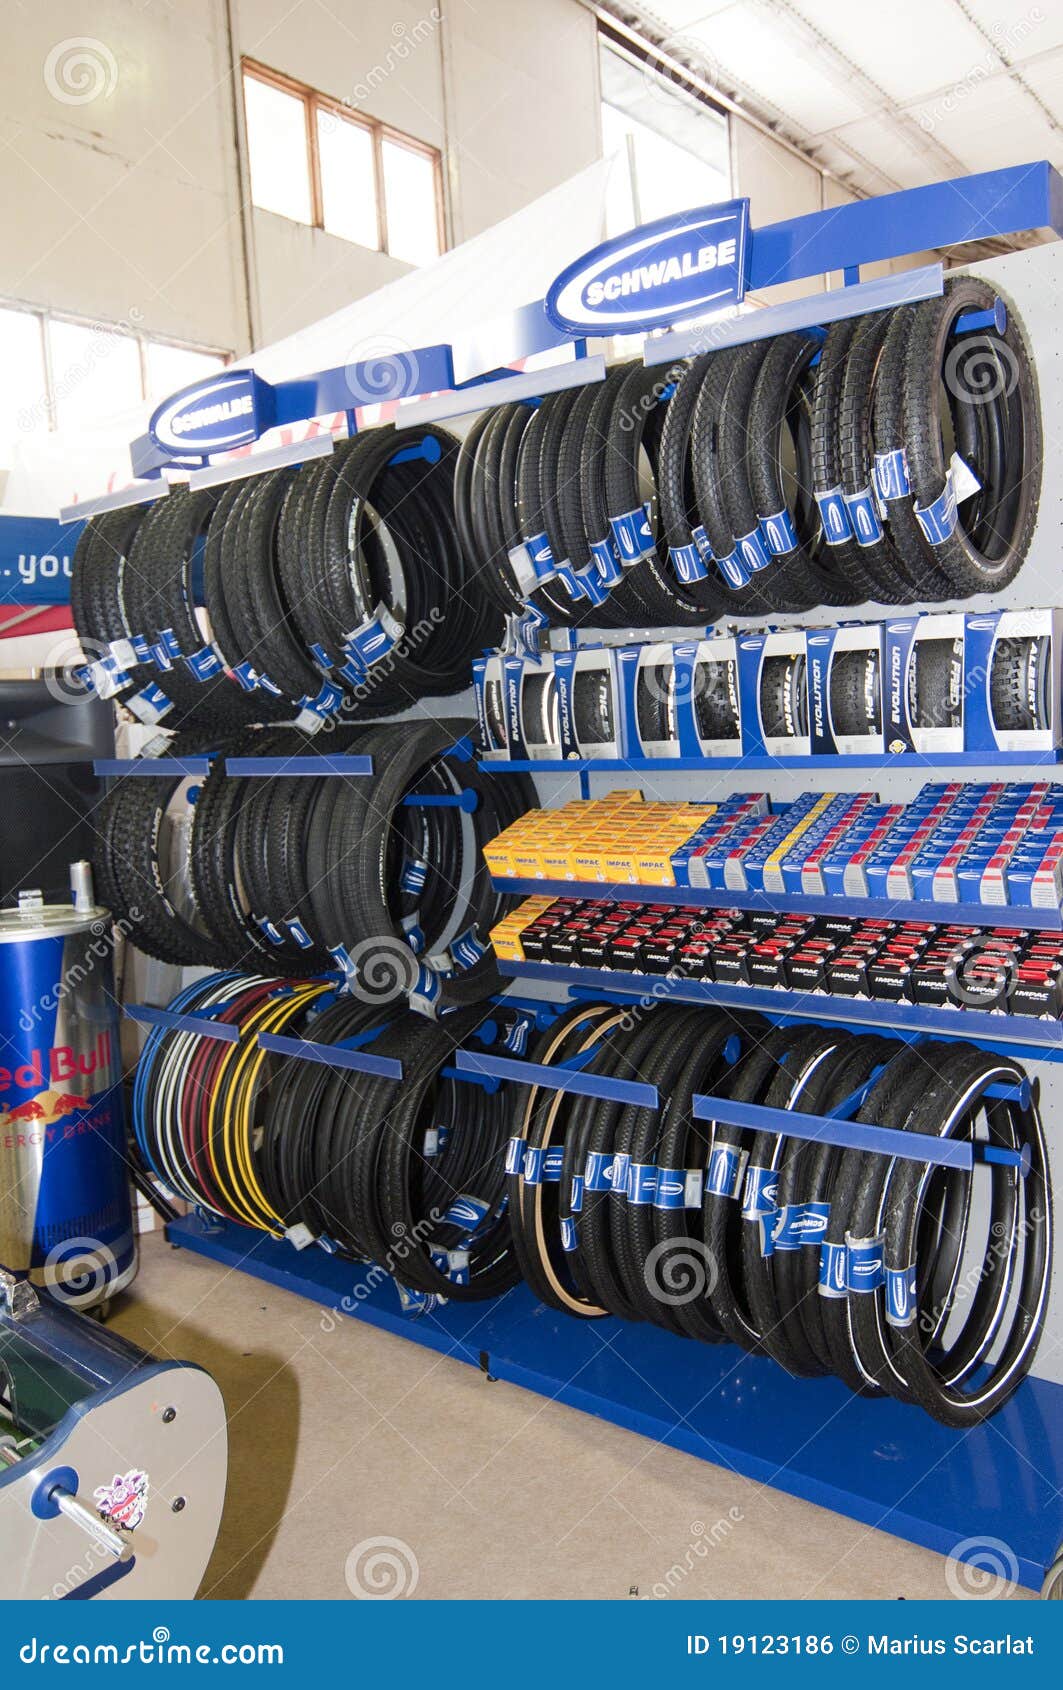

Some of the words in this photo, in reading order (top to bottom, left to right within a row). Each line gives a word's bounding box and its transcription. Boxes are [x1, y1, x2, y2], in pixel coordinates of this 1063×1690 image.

[586, 238, 737, 306] SCHWALBE
[783, 666, 795, 736] JIMM
[812, 659, 824, 737] EVOLUTION
[864, 660, 875, 719] RALPH
[891, 646, 901, 724] EVOLUTION
[950, 660, 961, 706] FRED
[1028, 642, 1039, 714] ALBERT
[509, 679, 519, 741] EVOLUTION
[560, 678, 570, 745] EVOLUTION
[576, 858, 599, 866] IMPAC
[832, 972, 860, 980] IMPAC
[918, 980, 948, 988] IMPAC
[967, 986, 999, 994] IMPAC
[1015, 990, 1048, 998] IMPAC
[49, 1029, 110, 1083] Bull
[63, 1111, 111, 1139] DRINK
